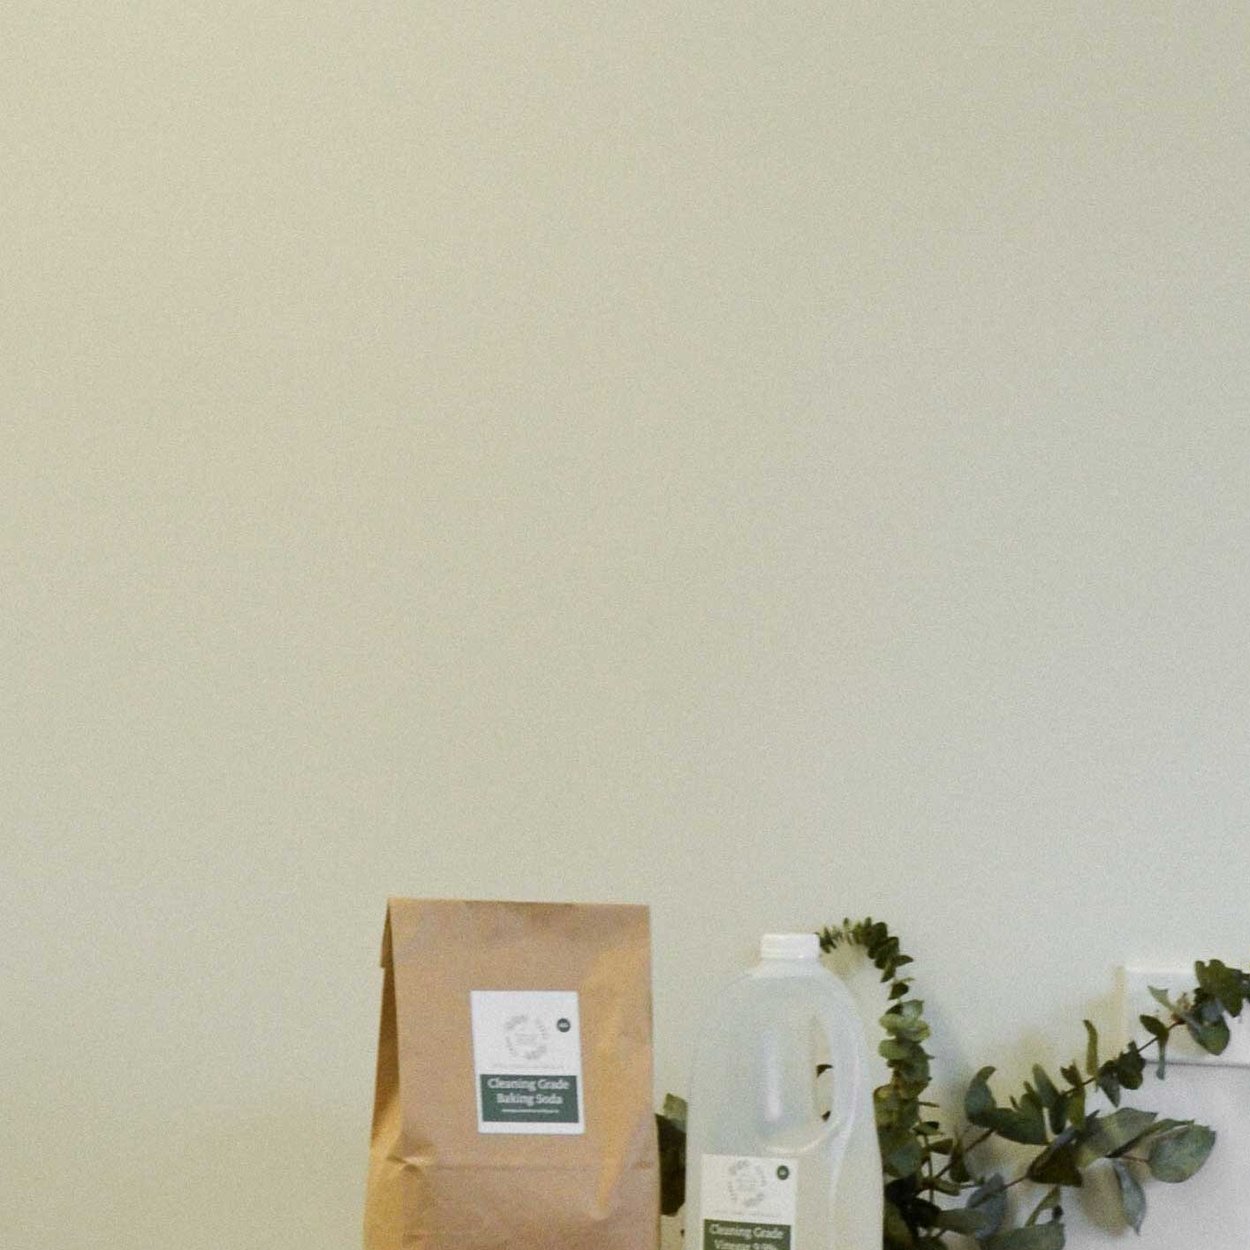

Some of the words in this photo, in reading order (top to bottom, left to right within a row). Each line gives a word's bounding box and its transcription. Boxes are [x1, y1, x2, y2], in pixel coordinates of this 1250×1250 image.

[487, 1078, 536, 1091] Cleaning
[537, 1078, 570, 1090] Grade
[496, 1092, 534, 1106] Baking
[535, 1093, 564, 1105] Soda
[708, 1223, 752, 1240] Cleaning
[752, 1226, 785, 1240] Grade
